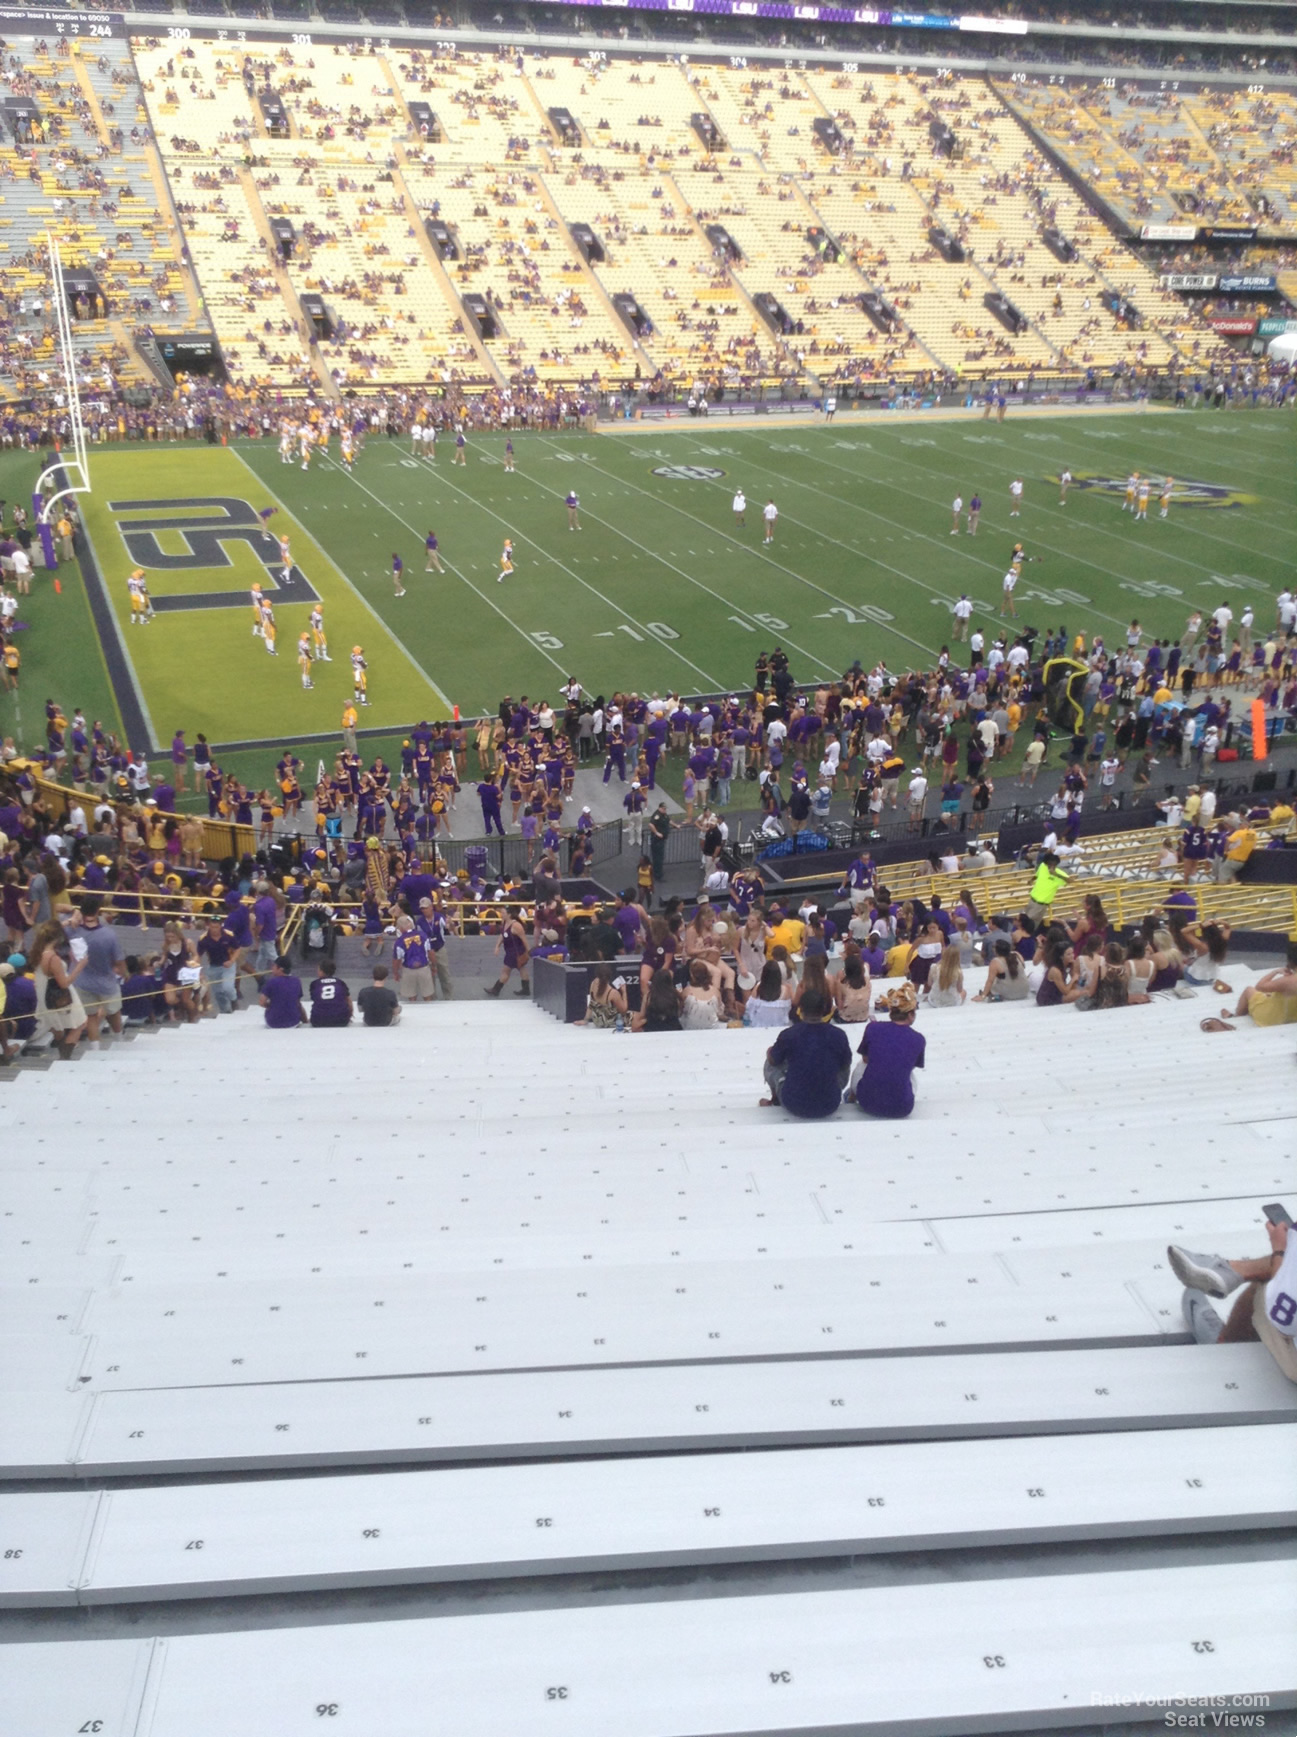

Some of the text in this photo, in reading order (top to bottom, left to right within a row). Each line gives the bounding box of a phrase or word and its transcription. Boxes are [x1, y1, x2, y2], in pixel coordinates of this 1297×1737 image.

[89, 25, 112, 37] 244
[168, 28, 190, 39] 300
[292, 34, 312, 45] 301
[842, 63, 858, 73] 305
[1186, 276, 1204, 286] POWER
[1242, 277, 1270, 286] BURNS
[654, 466, 723, 480] SEC
[1119, 580, 1185, 598] 35
[1026, 588, 1092, 606] 30
[829, 604, 895, 623] 20
[728, 613, 790, 632] 15
[617, 622, 681, 641] 10
[530, 631, 564, 649] 5
[1192, 833, 1200, 846] 5
[321, 985, 335, 1000] 8
[1270, 1292, 1297, 1326] 8
[1094, 1388, 1109, 1396] 30
[830, 1399, 845, 1407] 32
[695, 1405, 709, 1413] 33
[558, 1411, 572, 1419] 34
[274, 1424, 290, 1432] 36
[128, 1431, 145, 1439] 37
[1186, 1479, 1202, 1487] 31
[1027, 1488, 1044, 1497] 32
[868, 1498, 884, 1507] 33
[704, 1508, 720, 1517] 34
[536, 1518, 552, 1527] 35
[363, 1529, 380, 1538] 36
[185, 1540, 204, 1550] 37
[4, 1550, 23, 1559] 38
[1191, 1641, 1214, 1654] 32
[983, 1656, 1005, 1668] 33
[769, 1671, 791, 1684] 34
[547, 1687, 568, 1700] 35
[316, 1703, 338, 1717] 36
[78, 1720, 103, 1733] 37
